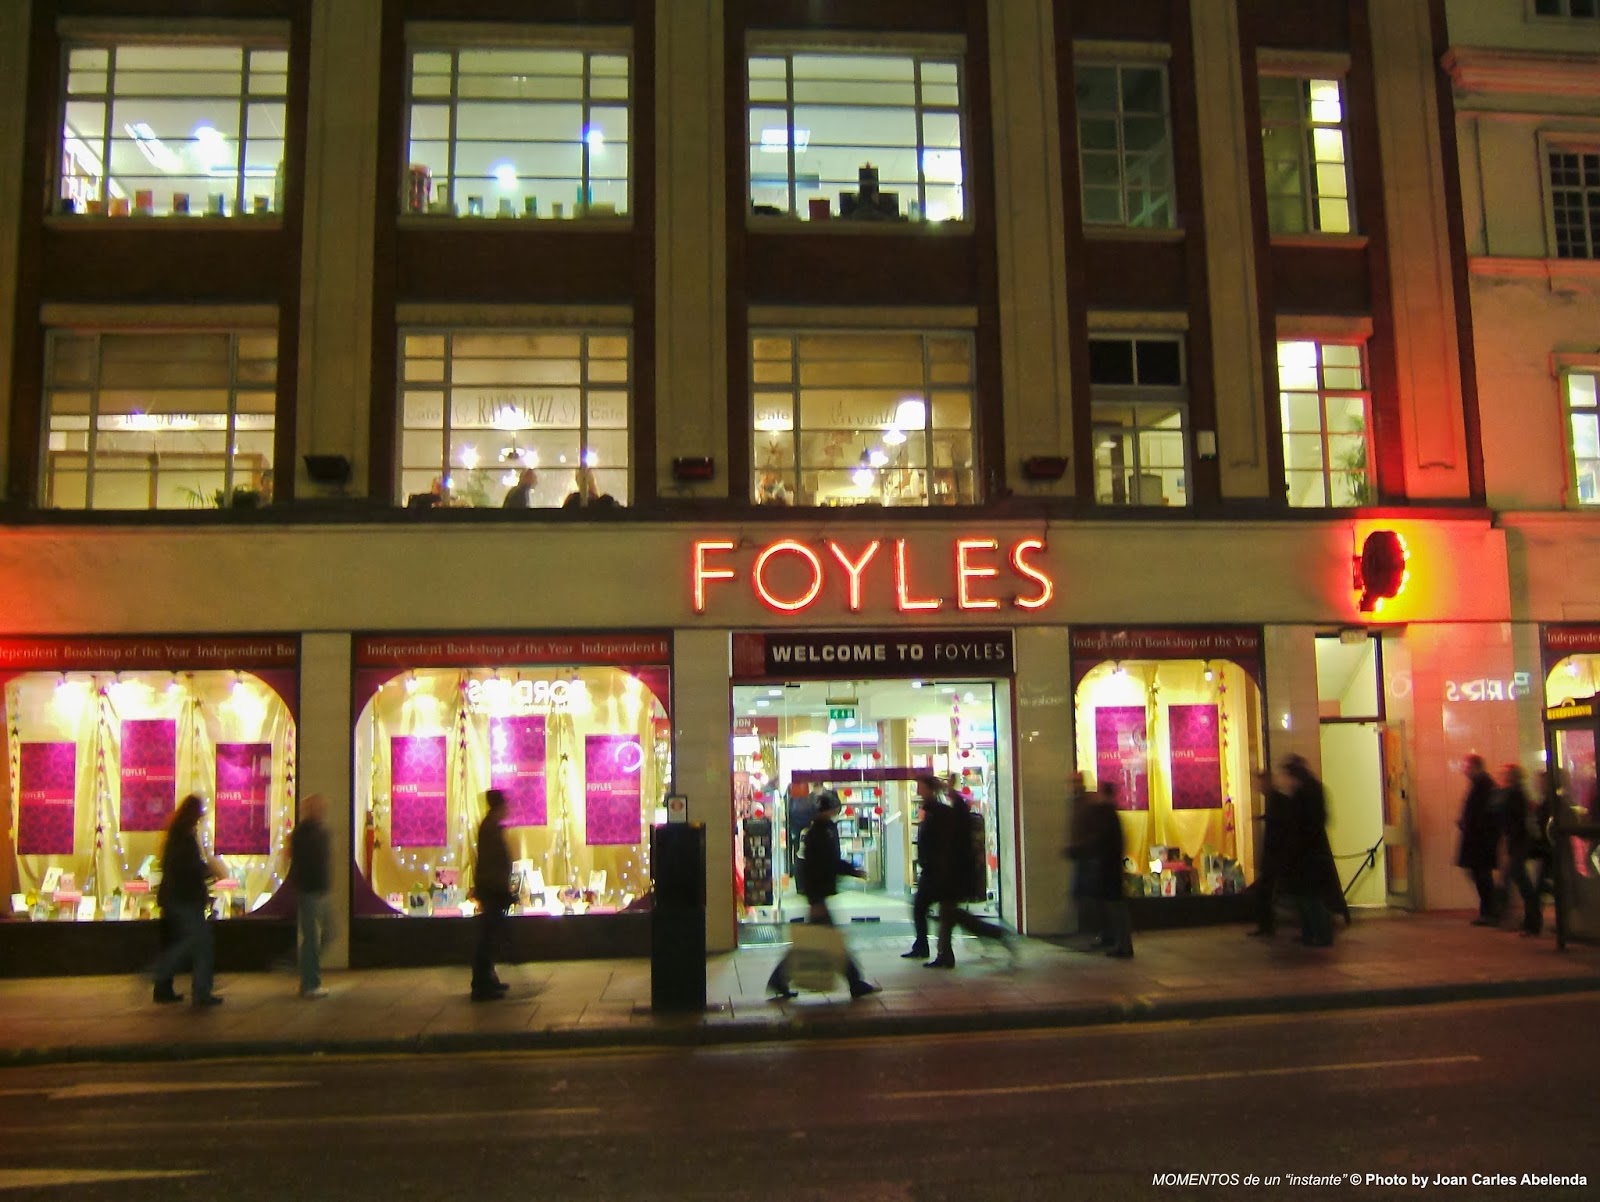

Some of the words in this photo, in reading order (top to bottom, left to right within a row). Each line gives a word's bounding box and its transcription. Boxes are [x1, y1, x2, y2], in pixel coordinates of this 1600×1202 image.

[694, 539, 1053, 613] FOYLES
[367, 643, 442, 658] Independent
[447, 643, 504, 657] Bookshop
[509, 643, 521, 654] of
[525, 642, 544, 654] the
[549, 642, 573, 654] Year
[582, 641, 656, 656] Independent
[1073, 637, 1142, 650] Independent
[1146, 636, 1197, 650] Bookshop
[1199, 636, 1210, 647] of
[1215, 636, 1231, 647] the
[64, 646, 121, 660] Bookshop
[125, 646, 137, 658] of
[142, 646, 159, 658] the
[165, 646, 190, 657] Year
[197, 645, 272, 659] Independent
[772, 644, 886, 662] WELCOME
[896, 644, 924, 661] TO
[934, 643, 1006, 660] FOYLES
